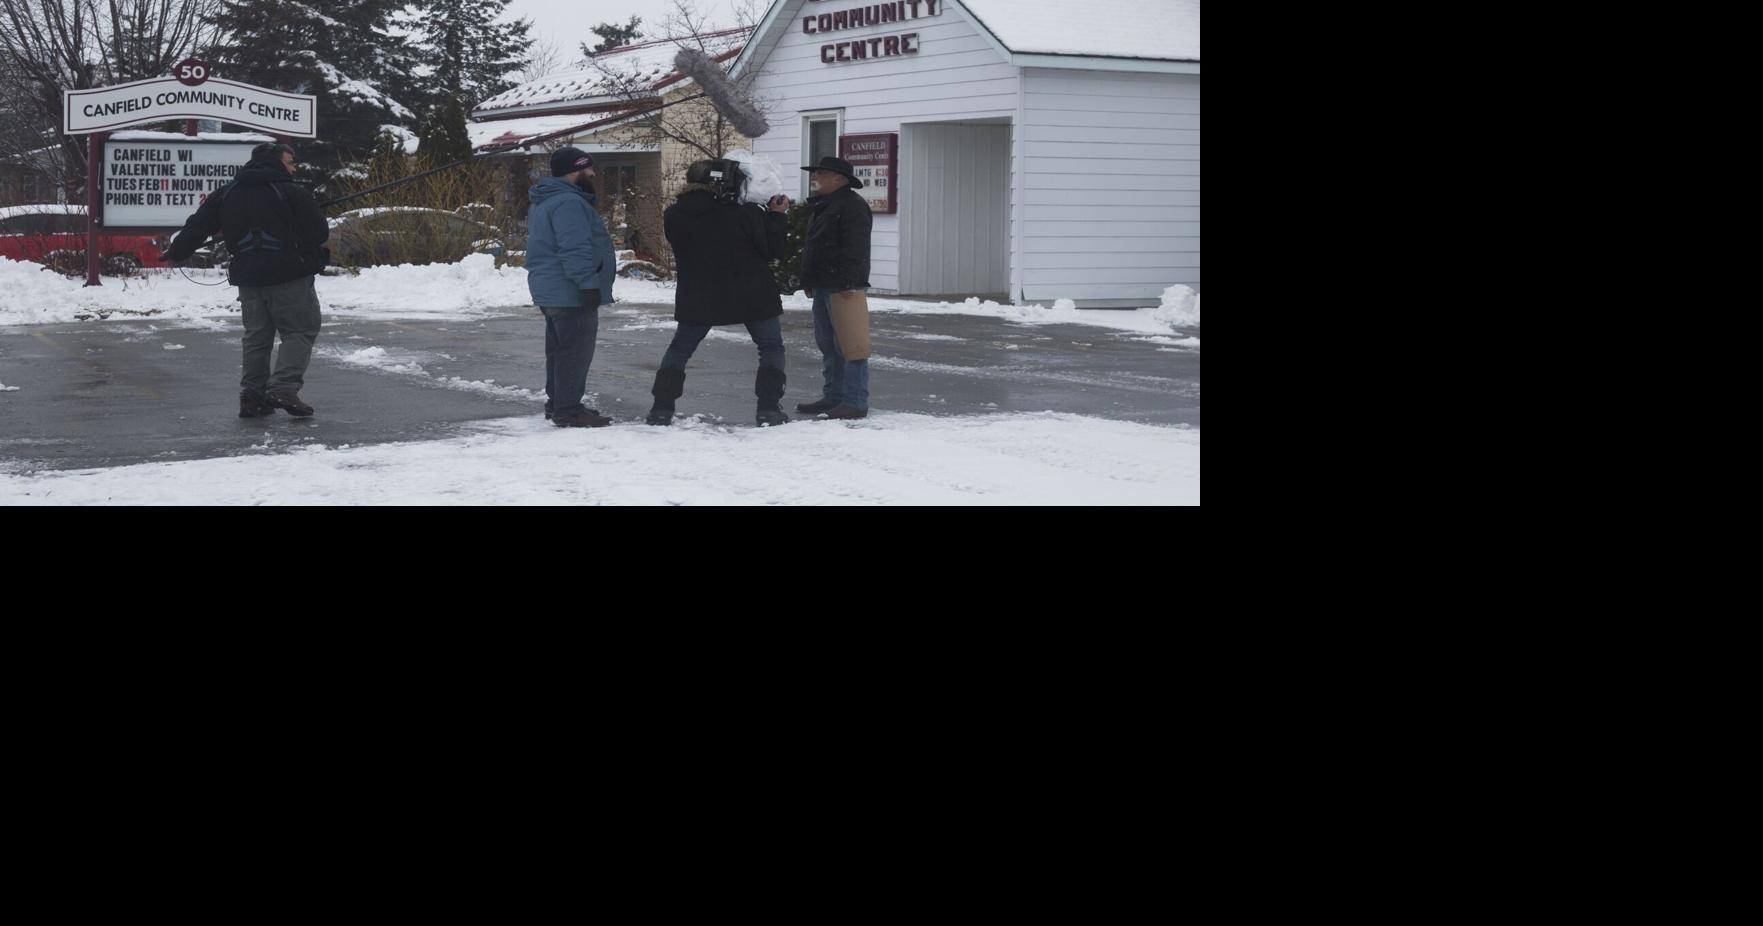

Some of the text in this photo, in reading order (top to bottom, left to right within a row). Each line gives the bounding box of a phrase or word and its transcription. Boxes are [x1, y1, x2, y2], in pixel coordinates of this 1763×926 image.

[802, 0, 937, 34] COMMUNITY
[820, 33, 918, 63] CENTRE
[180, 65, 205, 79] 50
[83, 91, 300, 121] CANFIELD COMMUNITY CENTRE
[113, 148, 193, 162] CANFIELD WI
[111, 163, 176, 177] VALENTINE
[107, 178, 137, 191] TUES
[171, 179, 203, 191] NOON
[106, 192, 145, 206] PHONE
[146, 193, 162, 206] OR
[164, 193, 195, 206] TEXT
